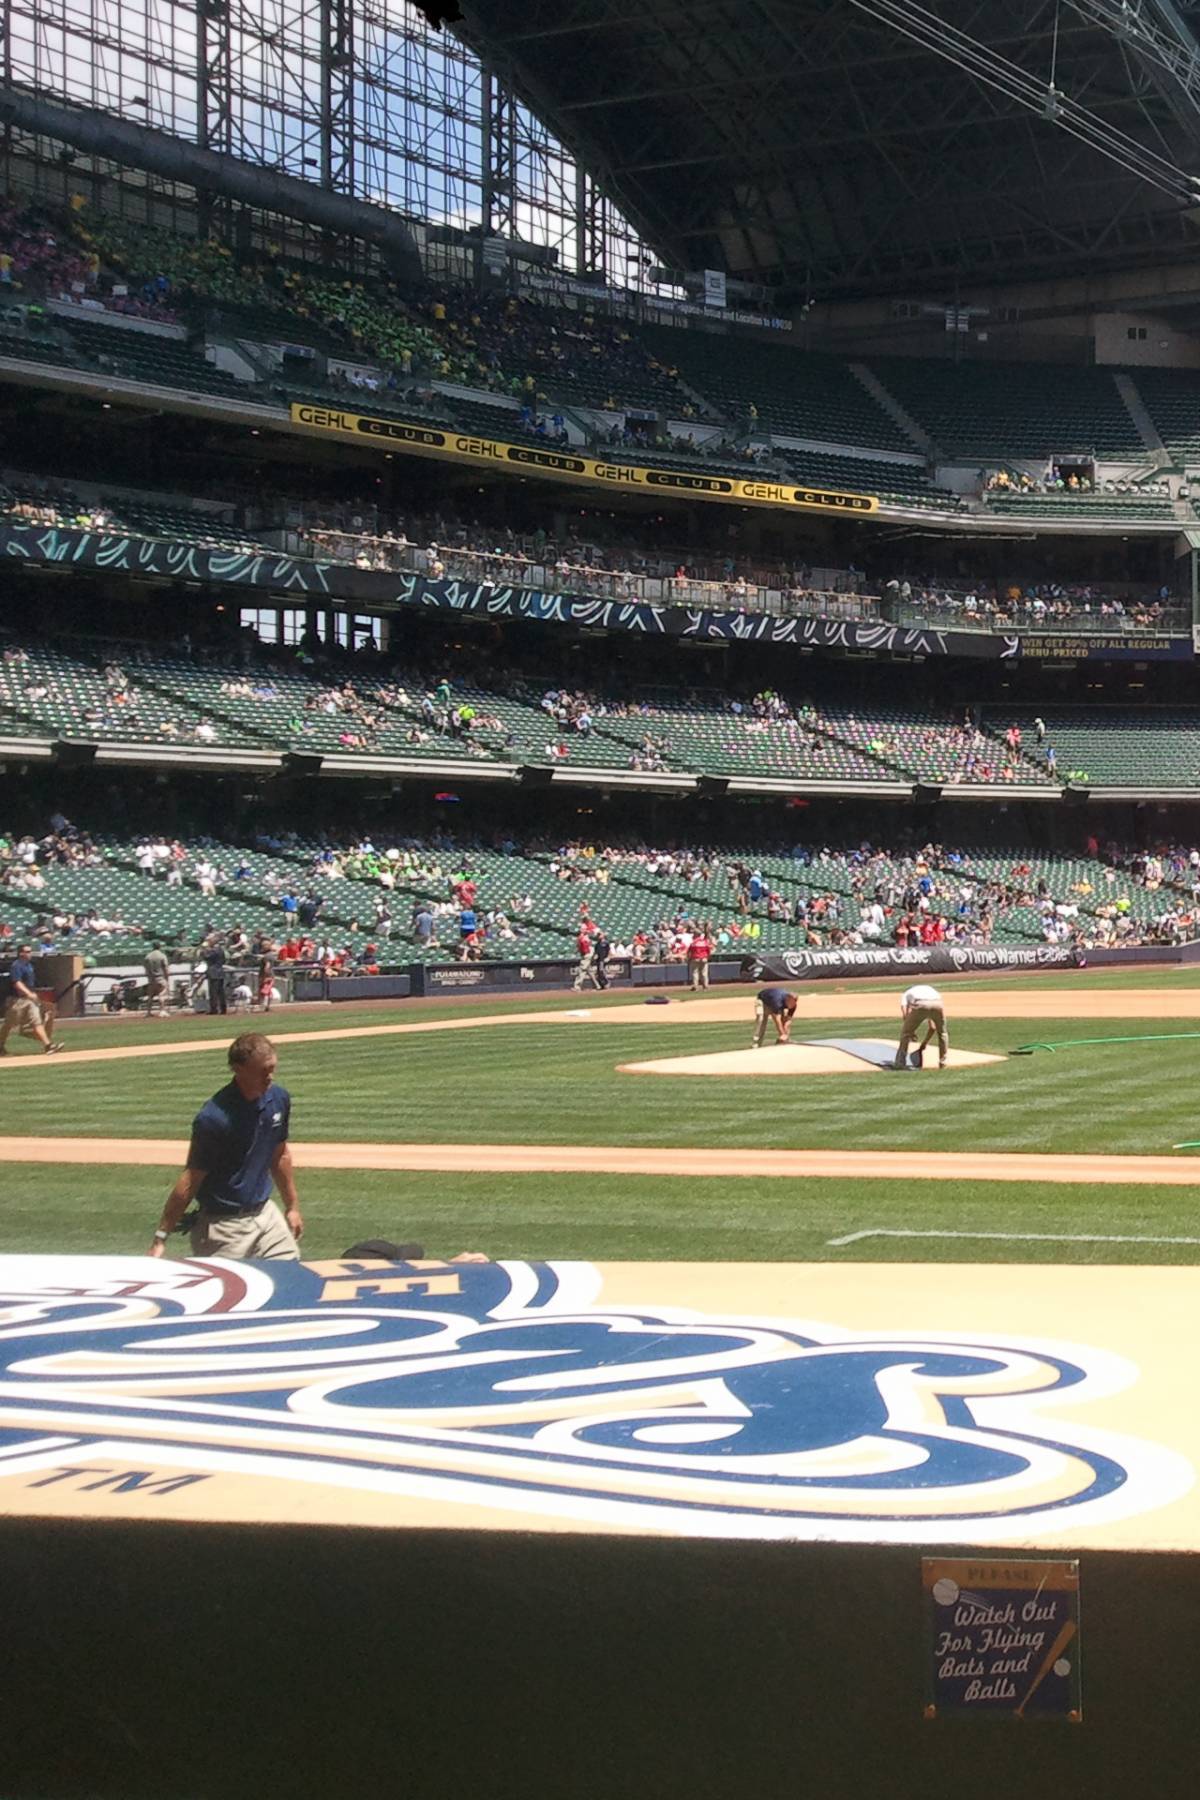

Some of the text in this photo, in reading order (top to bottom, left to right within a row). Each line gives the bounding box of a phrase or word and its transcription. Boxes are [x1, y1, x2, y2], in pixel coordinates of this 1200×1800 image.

[299, 408, 434, 442] GEHL CLUB
[456, 438, 575, 468] GEHL CLUB
[594, 465, 721, 490] GEHL CLUB
[743, 484, 862, 507] GEHL CLUB
[1045, 639, 1065, 648] GET
[1089, 639, 1108, 649] OFF
[1109, 640, 1126, 649] ALL
[1128, 640, 1170, 649] REGULAR
[802, 948, 928, 966] Time Warner Cable
[966, 948, 996, 965] Time
[994, 948, 1036, 965] Warner
[26, 1467, 214, 1495] TM
[967, 1567, 1029, 1581] PLEASE
[954, 1602, 1056, 1626] Watch Out
[935, 1627, 1045, 1656] For Flying
[938, 1652, 1032, 1679] Bats and
[965, 1678, 1016, 1701] Balls
